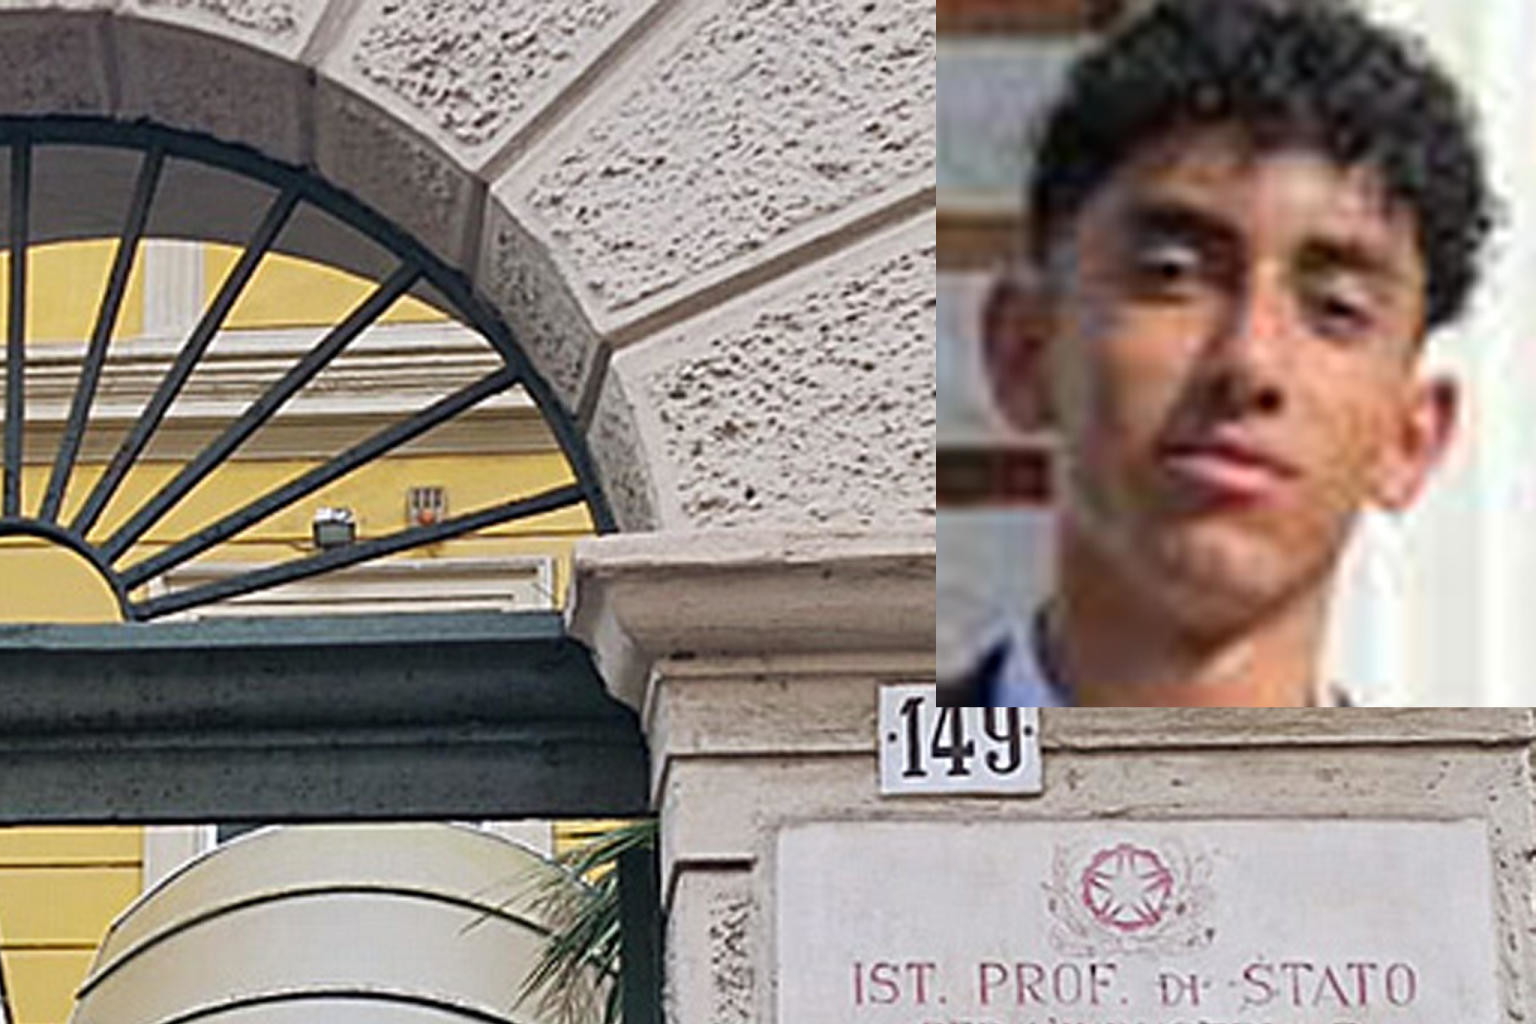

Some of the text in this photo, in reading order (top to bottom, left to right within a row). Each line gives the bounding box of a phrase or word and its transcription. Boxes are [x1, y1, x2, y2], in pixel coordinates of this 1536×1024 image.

[899, 696, 1022, 777] 149
[853, 962, 947, 1005] IST.
[978, 962, 1128, 1006] PROF.
[1242, 961, 1417, 1007] STATO
